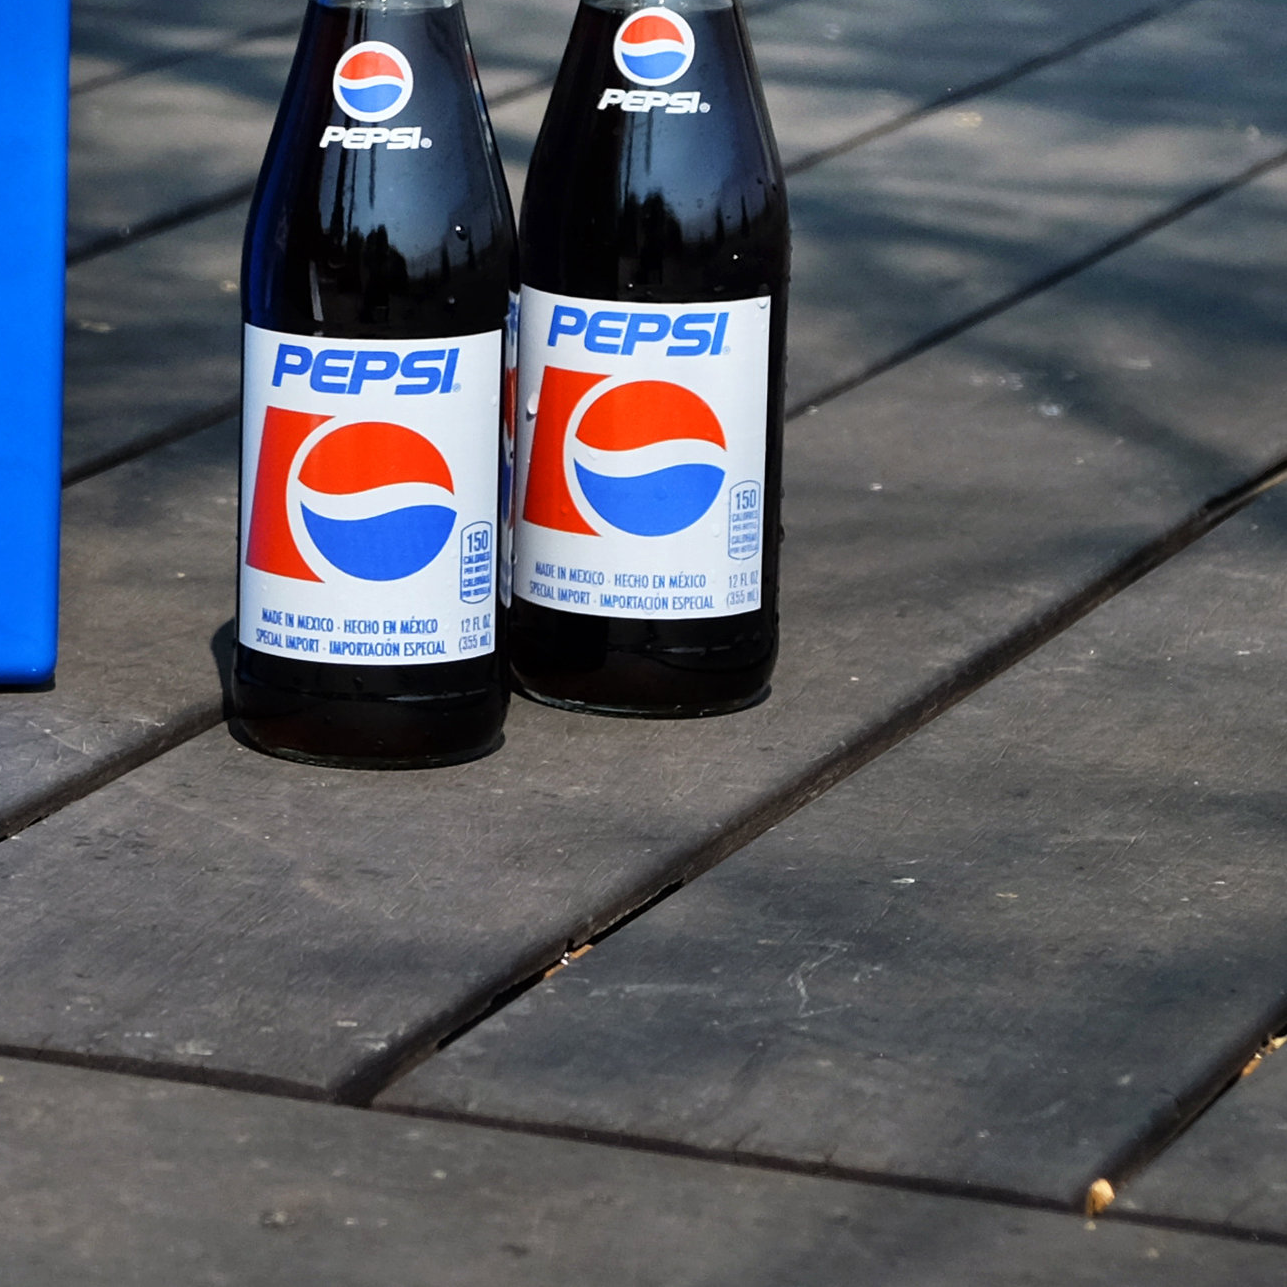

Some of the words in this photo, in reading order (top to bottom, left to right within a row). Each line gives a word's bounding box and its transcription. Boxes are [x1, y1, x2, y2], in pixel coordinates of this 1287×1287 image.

[597, 88, 702, 113] PEPSI
[319, 126, 422, 150] PEPSI
[547, 304, 729, 356] PEPSI
[271, 343, 460, 395] PEPSI
[736, 489, 756, 510] 150
[467, 530, 489, 553] 150
[535, 562, 555, 579] MADE
[557, 566, 566, 580] IN
[569, 568, 605, 585] MEXICO
[614, 574, 649, 588] HECHO
[653, 575, 665, 588] EN
[669, 571, 706, 588] MÉXICO
[729, 574, 738, 588] 12
[740, 572, 748, 586] FL
[529, 581, 555, 601] SPECIAL
[558, 587, 591, 605] IMPORT
[600, 593, 669, 610] IMPORTACIÓN
[672, 595, 715, 610] ESPECIAL
[262, 608, 283, 625] MADE
[285, 613, 294, 628] IN
[297, 615, 333, 632] MEXICO
[344, 619, 379, 634] HECHO
[383, 620, 396, 634] EN
[400, 615, 438, 634] MÉXICO
[461, 617, 470, 633] 12
[473, 616, 480, 631] FL
[256, 628, 283, 648] SPECIAL
[285, 635, 319, 652] IMPORT
[329, 638, 400, 656] IMPORTACIÓN
[404, 640, 447, 656] ESPECIAL
